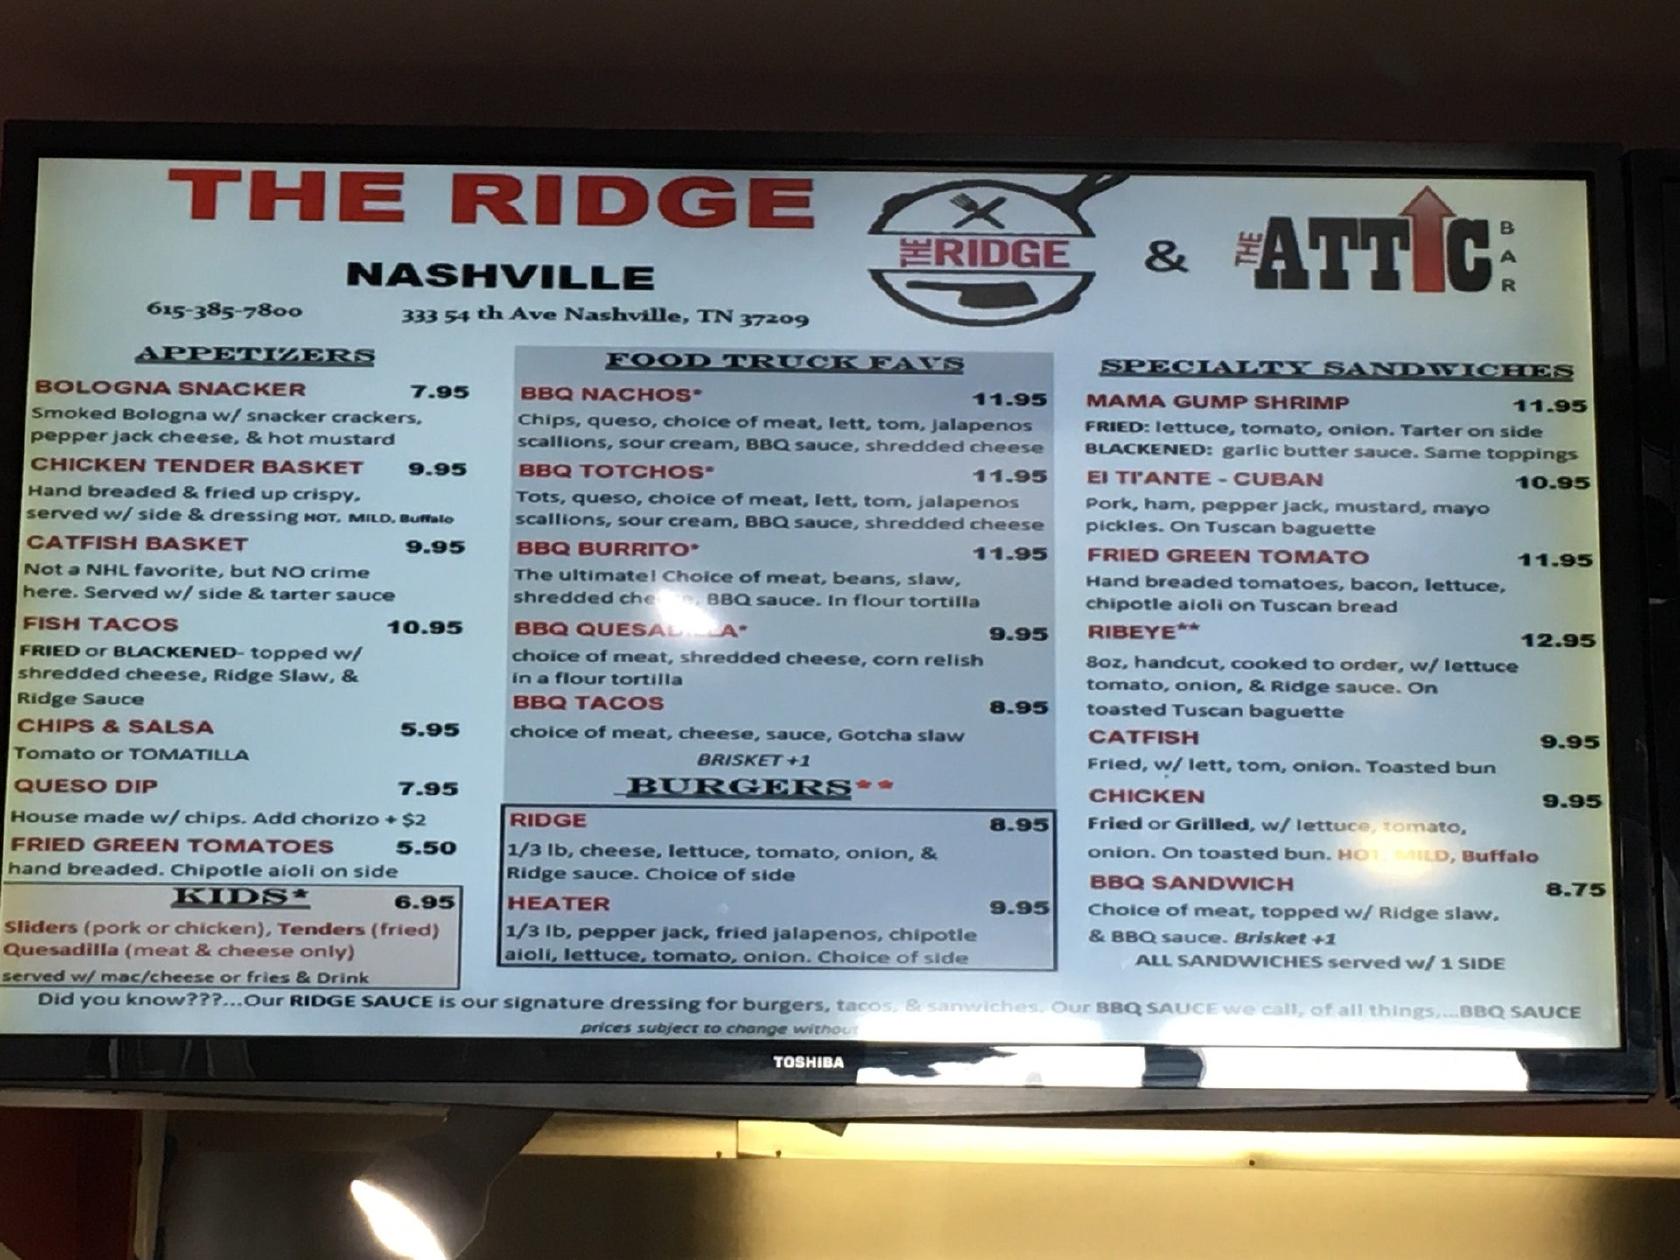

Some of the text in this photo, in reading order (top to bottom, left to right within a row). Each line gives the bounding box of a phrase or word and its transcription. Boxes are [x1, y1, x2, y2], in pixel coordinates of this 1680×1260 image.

[168, 168, 815, 229] THE RIDGE
[1234, 186, 1494, 294] THE ATTIC
[900, 237, 1071, 270] THE RIDGE
[1144, 239, 1189, 274] &
[346, 261, 655, 291] NASHVILLE
[145, 298, 304, 323] 615-385-7800
[401, 303, 811, 329] 333 54 th Ave Nashville, TN 37209
[134, 344, 376, 368] APPETIZERS
[605, 351, 965, 375] FOOD TRUCK FAVS
[1099, 358, 1575, 382] SPECIALTY SANDWICHES
[33, 378, 471, 400] BOLOGNA SNACKER 7.95
[519, 385, 576, 403] BBQ
[970, 390, 1049, 409] 11.95
[1085, 392, 1590, 415] MAMA GUMP SHRIMP 11.95
[30, 405, 423, 426] Smoked Bologna w/ snacker crackers,
[516, 434, 1044, 455] scallions, sour cream, BBQ sauce, shredded cheese
[29, 455, 468, 478] CHICKEN TENDER BASKET 9.95
[517, 462, 574, 480] BBQ
[972, 468, 1049, 485] 11.95
[1232, 471, 1324, 488] CUBAN
[1514, 474, 1593, 492] 10.95
[1085, 518, 1377, 539] pickles. On Tuscan baguette
[25, 533, 467, 556] CATFISH BASKET 9.95
[515, 539, 572, 558] BBQ
[972, 545, 1050, 563] 11.95
[1086, 546, 1595, 569] FRIED GREEN TOMATO 11.95
[21, 614, 464, 636] FISH TACOS 10.95
[513, 619, 570, 638] BBQ
[987, 625, 1051, 643] 9.95
[1519, 631, 1598, 650] 12.95
[16, 690, 146, 710] Ridge Sauce
[512, 693, 1051, 717] BBQ TACOS 8.95
[1086, 702, 1346, 722] toasted Tuscan baguette
[15, 717, 461, 739] CHIPS & SALSA 5.95
[1087, 728, 1602, 751] CATFISH 9.95
[12, 745, 251, 762] Tomato or TOMATILLA
[696, 751, 811, 769] BRISKET +1
[12, 777, 460, 798] QUESO DIP 7.95
[1087, 787, 1605, 810] CHICKEN 9.95
[9, 808, 427, 829] House made w/ chips. Add chorizo + $2
[508, 811, 1051, 834] RIDGE 8.95
[9, 835, 458, 857] FRIED GREEN TOMATOES 5.50
[505, 864, 797, 885] Ridge sauce. Choice of side
[1089, 873, 1608, 899] BBQ SANDWICH 8.75
[393, 893, 457, 911] 6.95
[506, 895, 1052, 917] HEATER 9.95
[1, 941, 356, 963] Quesadilla (meat & cheese only)
[1134, 953, 1507, 972] ALL SANDWICHES served w/ 1 SIDE
[36, 990, 76, 1007] Did
[78, 994, 122, 1011] you
[288, 993, 357, 1009] RIDGE
[360, 994, 434, 1010] SAUCE
[437, 995, 458, 1010] is
[460, 996, 500, 1010] our
[502, 995, 606, 1014] signature
[609, 995, 703, 1016] dressing
[705, 995, 739, 1013] for
[741, 996, 830, 1016] burgers,
[578, 1020, 633, 1036] prices
[635, 1021, 701, 1037] subject
[702, 1022, 724, 1037] to
[725, 1022, 789, 1040] change
[772, 1054, 845, 1071] TOSHIBA
